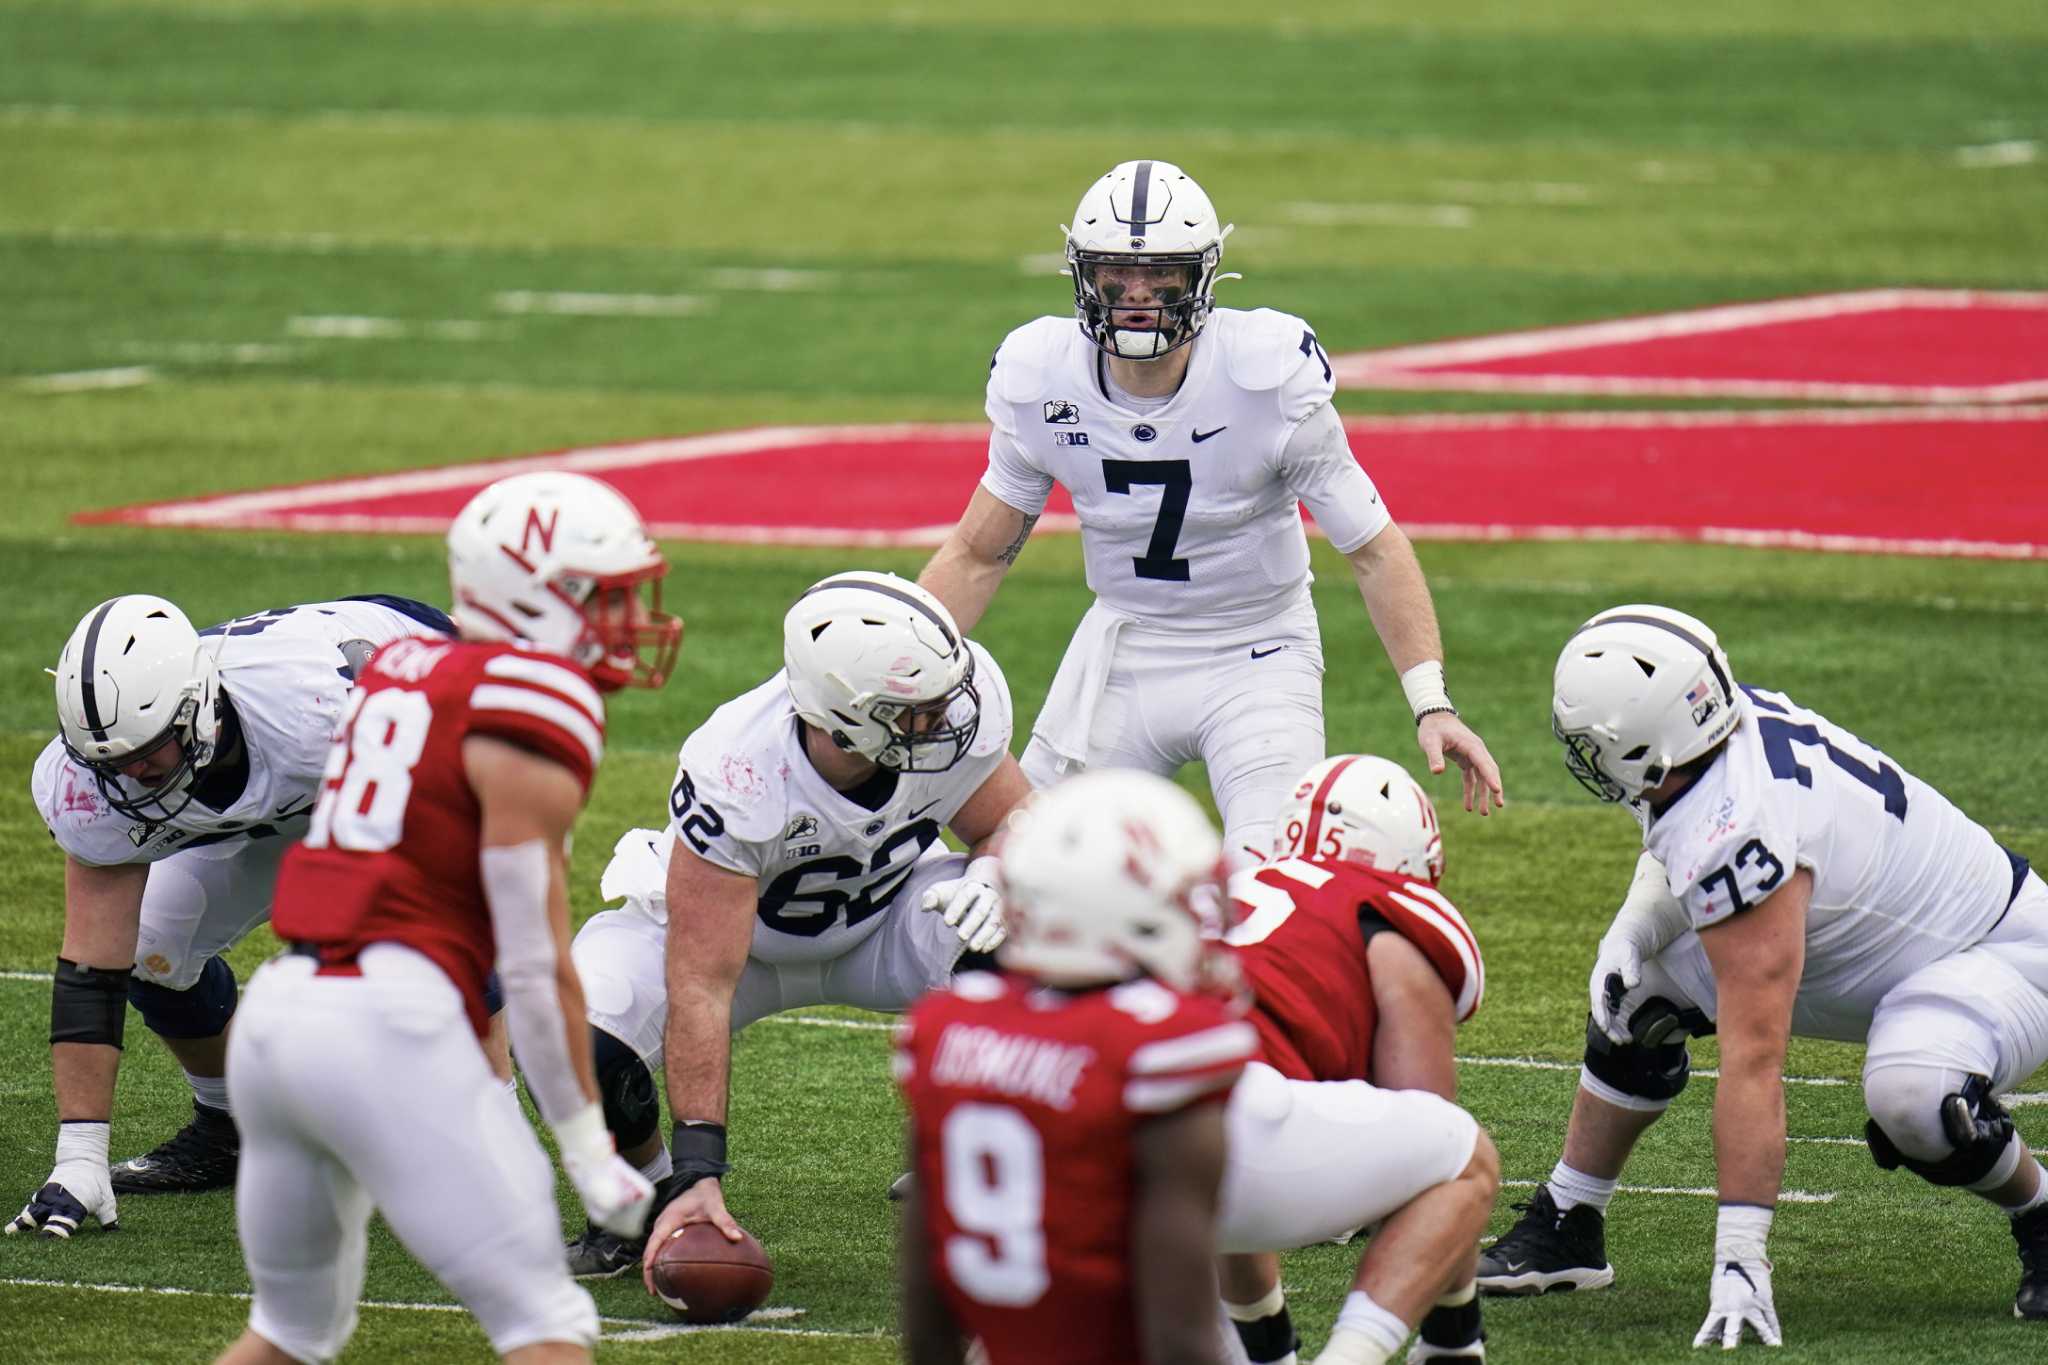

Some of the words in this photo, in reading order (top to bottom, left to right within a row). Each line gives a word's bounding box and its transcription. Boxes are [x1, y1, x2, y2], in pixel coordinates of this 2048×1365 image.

[1298, 330, 1331, 383] 7
[522, 507, 560, 554] N
[1101, 459, 1192, 582] 7
[669, 768, 726, 855] 62
[1286, 820, 1345, 859] 95
[756, 817, 942, 937] 62
[1698, 838, 1785, 914] 73
[944, 1104, 1050, 1307] 9
